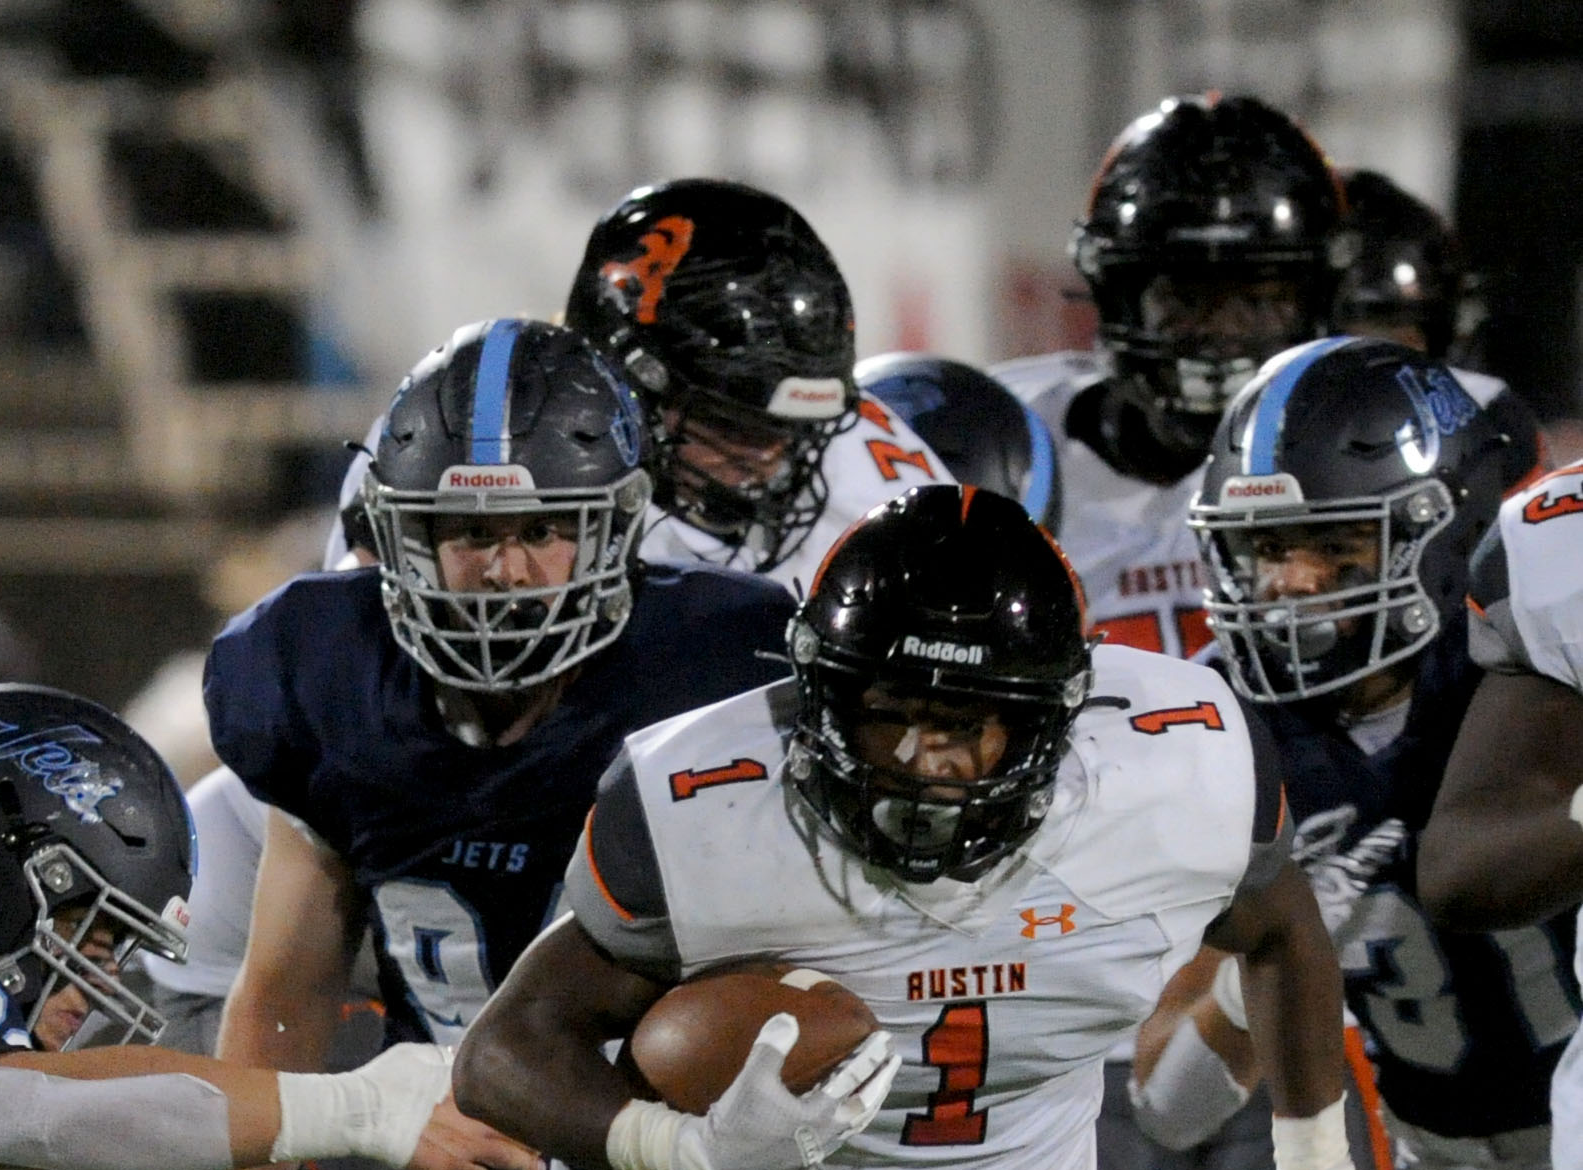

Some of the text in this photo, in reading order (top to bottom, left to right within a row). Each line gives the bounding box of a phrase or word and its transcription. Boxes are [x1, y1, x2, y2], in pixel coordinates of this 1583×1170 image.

[449, 473, 521, 488] Riddell
[902, 634, 983, 665] Riddell
[1129, 700, 1226, 736] 1
[668, 757, 769, 803] 1
[441, 839, 531, 873] JETS
[907, 962, 1027, 1002] AUSTIN
[899, 1001, 989, 1146] 1
